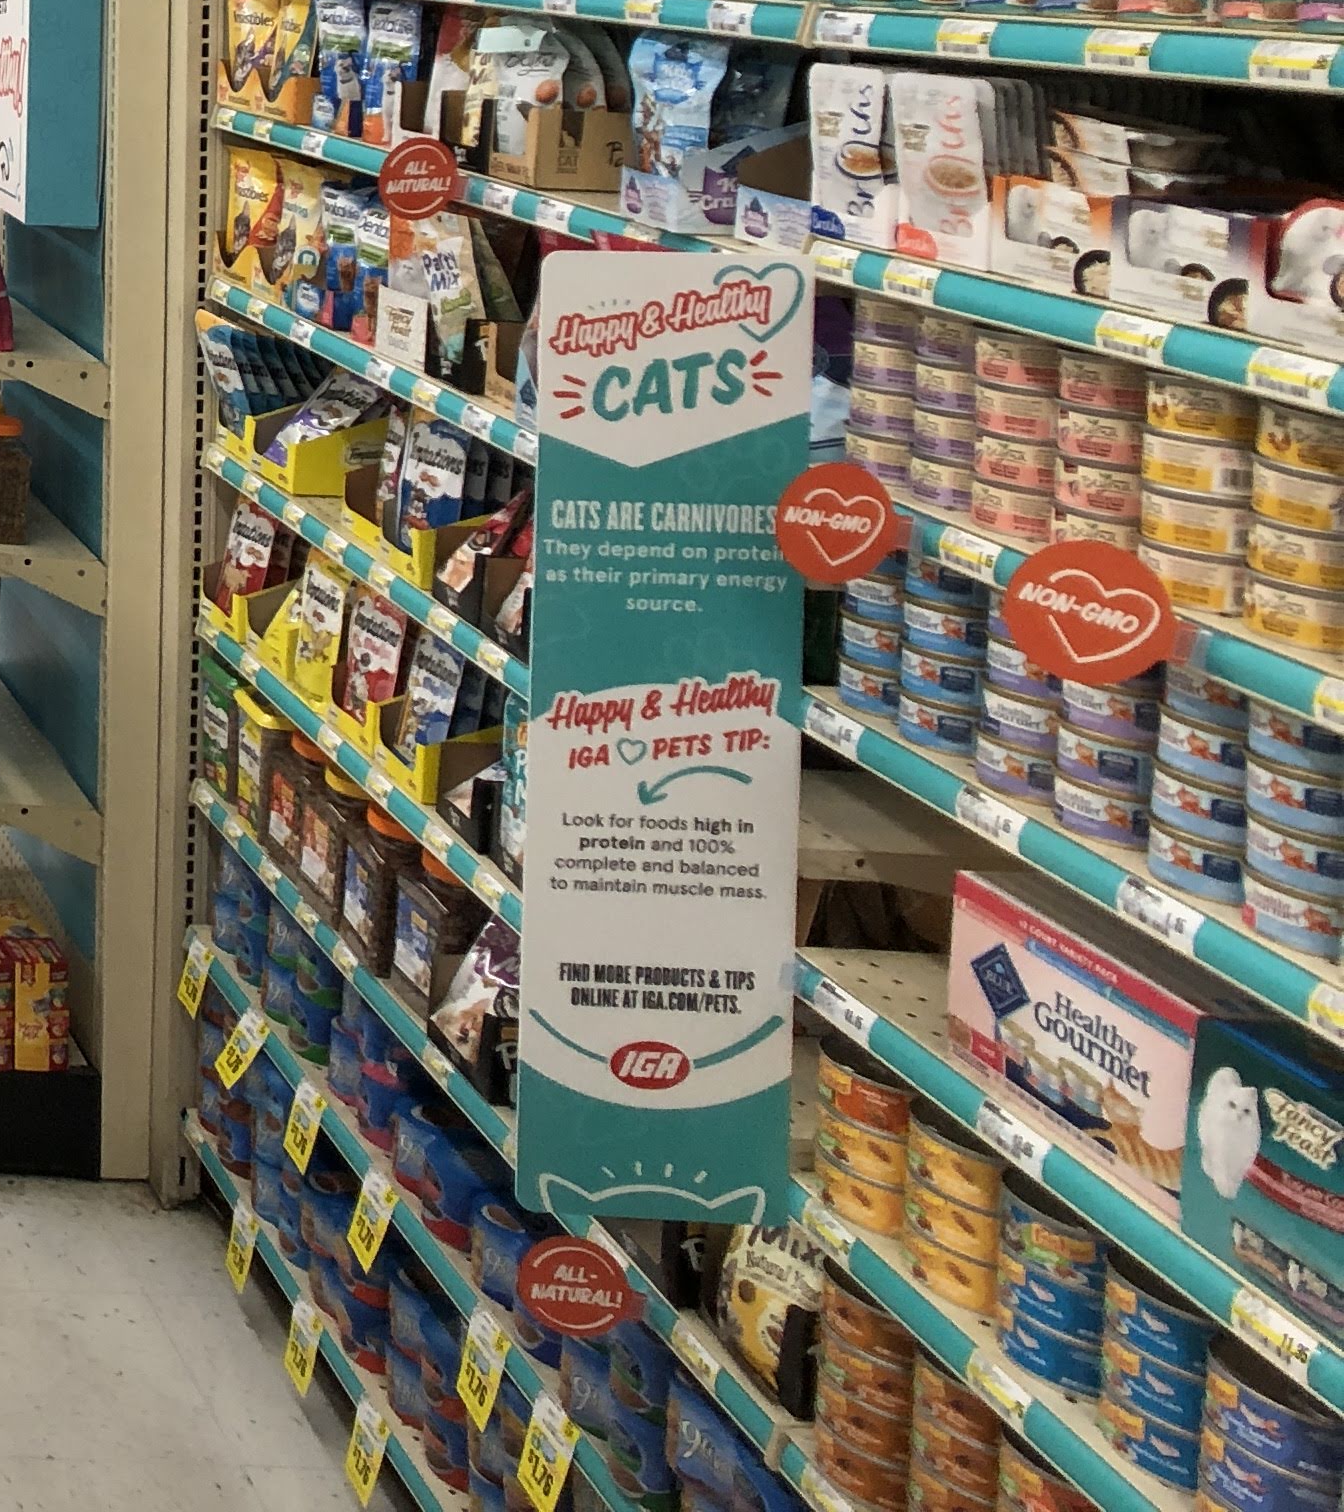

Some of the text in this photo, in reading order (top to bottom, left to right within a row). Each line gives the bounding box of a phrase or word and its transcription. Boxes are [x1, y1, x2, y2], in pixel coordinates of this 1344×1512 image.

[404, 161, 435, 175] ALL-
[386, 177, 451, 194] NATURAL!
[423, 251, 458, 276] Party
[430, 274, 462, 293] Mix
[547, 280, 772, 357] Happy & Healthy
[593, 348, 747, 422] CATS
[552, 500, 601, 529] CATS
[607, 501, 644, 531] ARE
[784, 507, 872, 534] NON-GMO
[544, 538, 784, 565] They depend on protei
[545, 567, 788, 592] as their primary energy
[626, 597, 704, 612] source.
[1019, 583, 1141, 633] NON-GMO
[547, 676, 775, 734] Happy & Healthy
[569, 729, 771, 768] IGA PETS TIP:
[563, 812, 754, 835] Look for foods high in
[579, 835, 735, 854] protein and 100%
[555, 856, 760, 877] complete and balanced
[550, 878, 767, 899] to maintain muscle mass.
[559, 963, 756, 990] FIND MORE PRODUCTS & TIPS
[571, 988, 620, 1008] ONLINE
[623, 989, 638, 1009] AT
[1055, 991, 1138, 1058] Healthy
[1034, 1001, 1152, 1098] Gourmet
[619, 1050, 684, 1079] IGA
[554, 1264, 599, 1283] ALL-
[532, 1284, 623, 1308] NATURAL!
